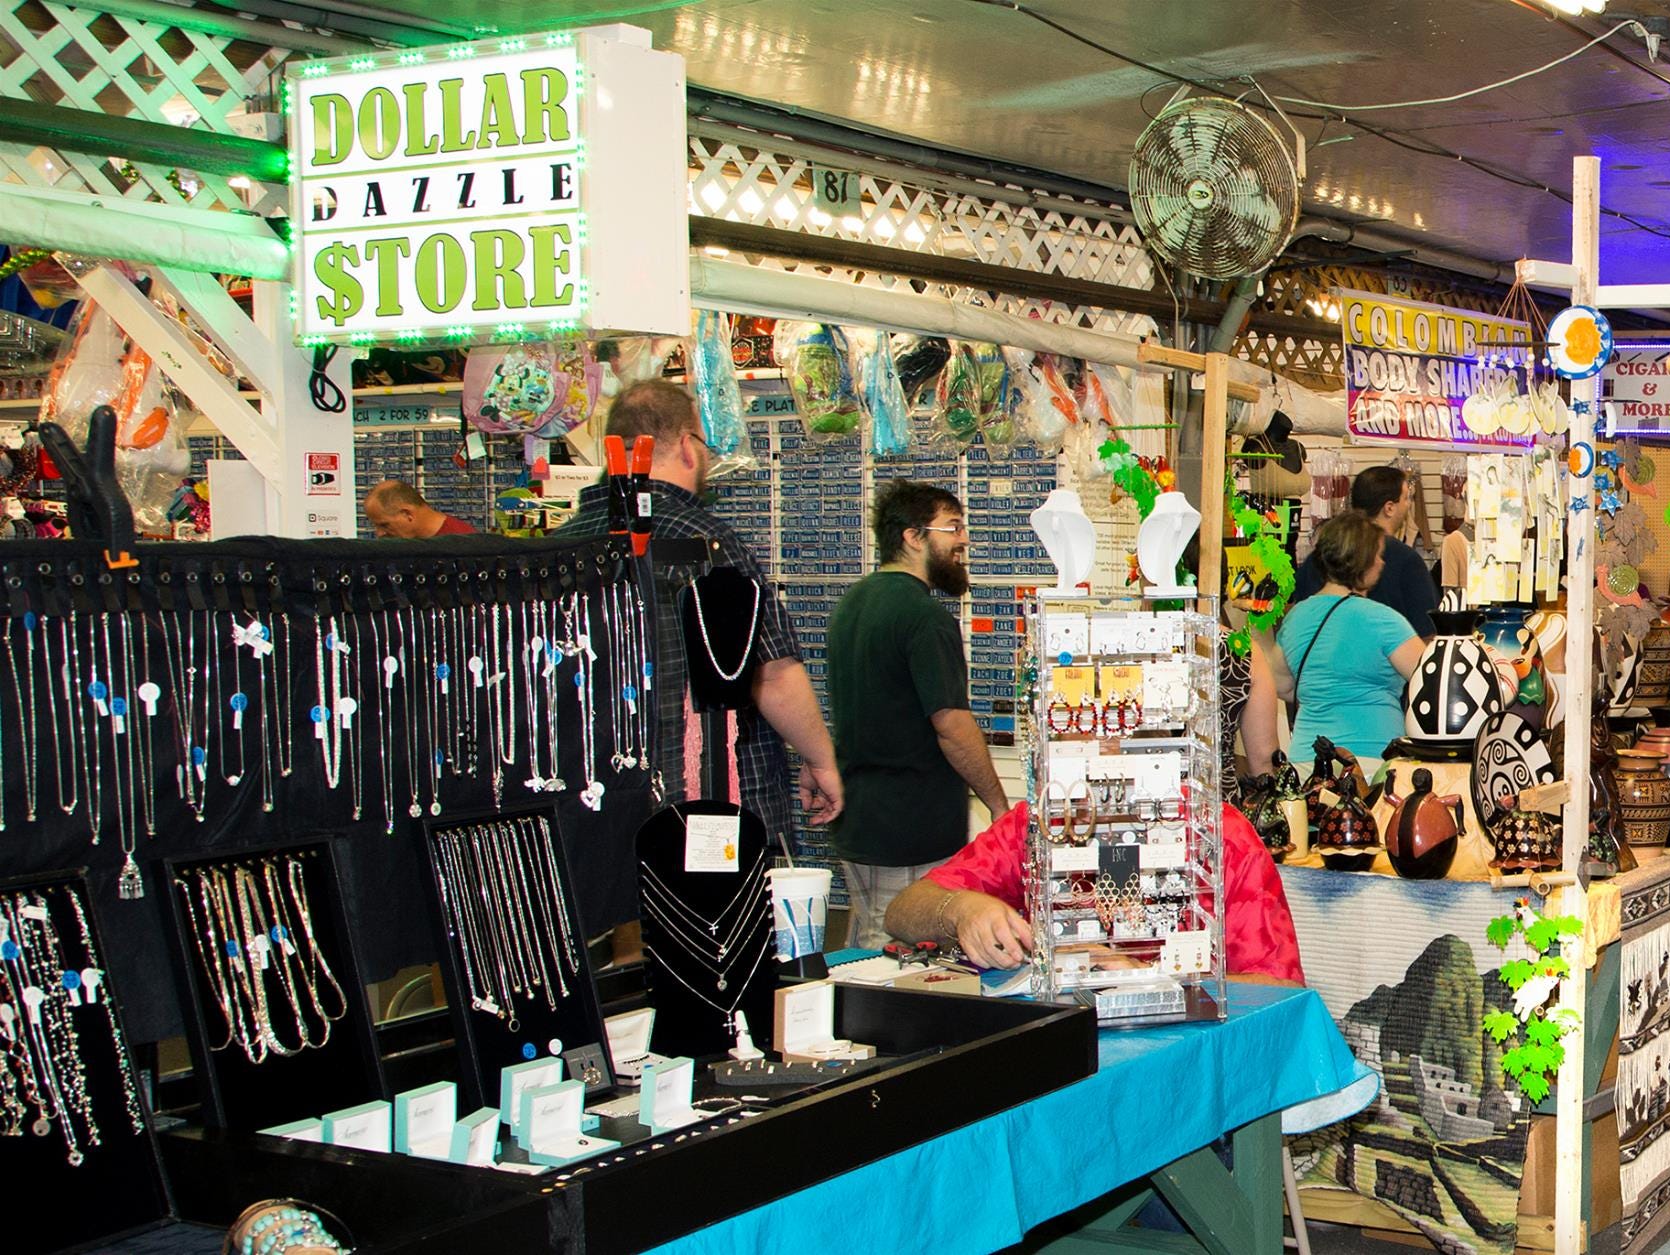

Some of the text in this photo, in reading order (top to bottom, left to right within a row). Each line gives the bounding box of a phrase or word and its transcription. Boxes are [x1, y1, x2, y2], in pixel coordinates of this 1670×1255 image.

[310, 67, 571, 166] DOLLAR
[311, 162, 574, 222] DAZZLE
[824, 170, 849, 204] 81
[314, 223, 574, 327] $TORE
[1348, 302, 1527, 365] COLOMBIAN
[1353, 350, 1420, 395] BODY
[1642, 382, 1657, 396] &
[390, 409, 410, 421] FOR
[1355, 397, 1401, 436] AND
